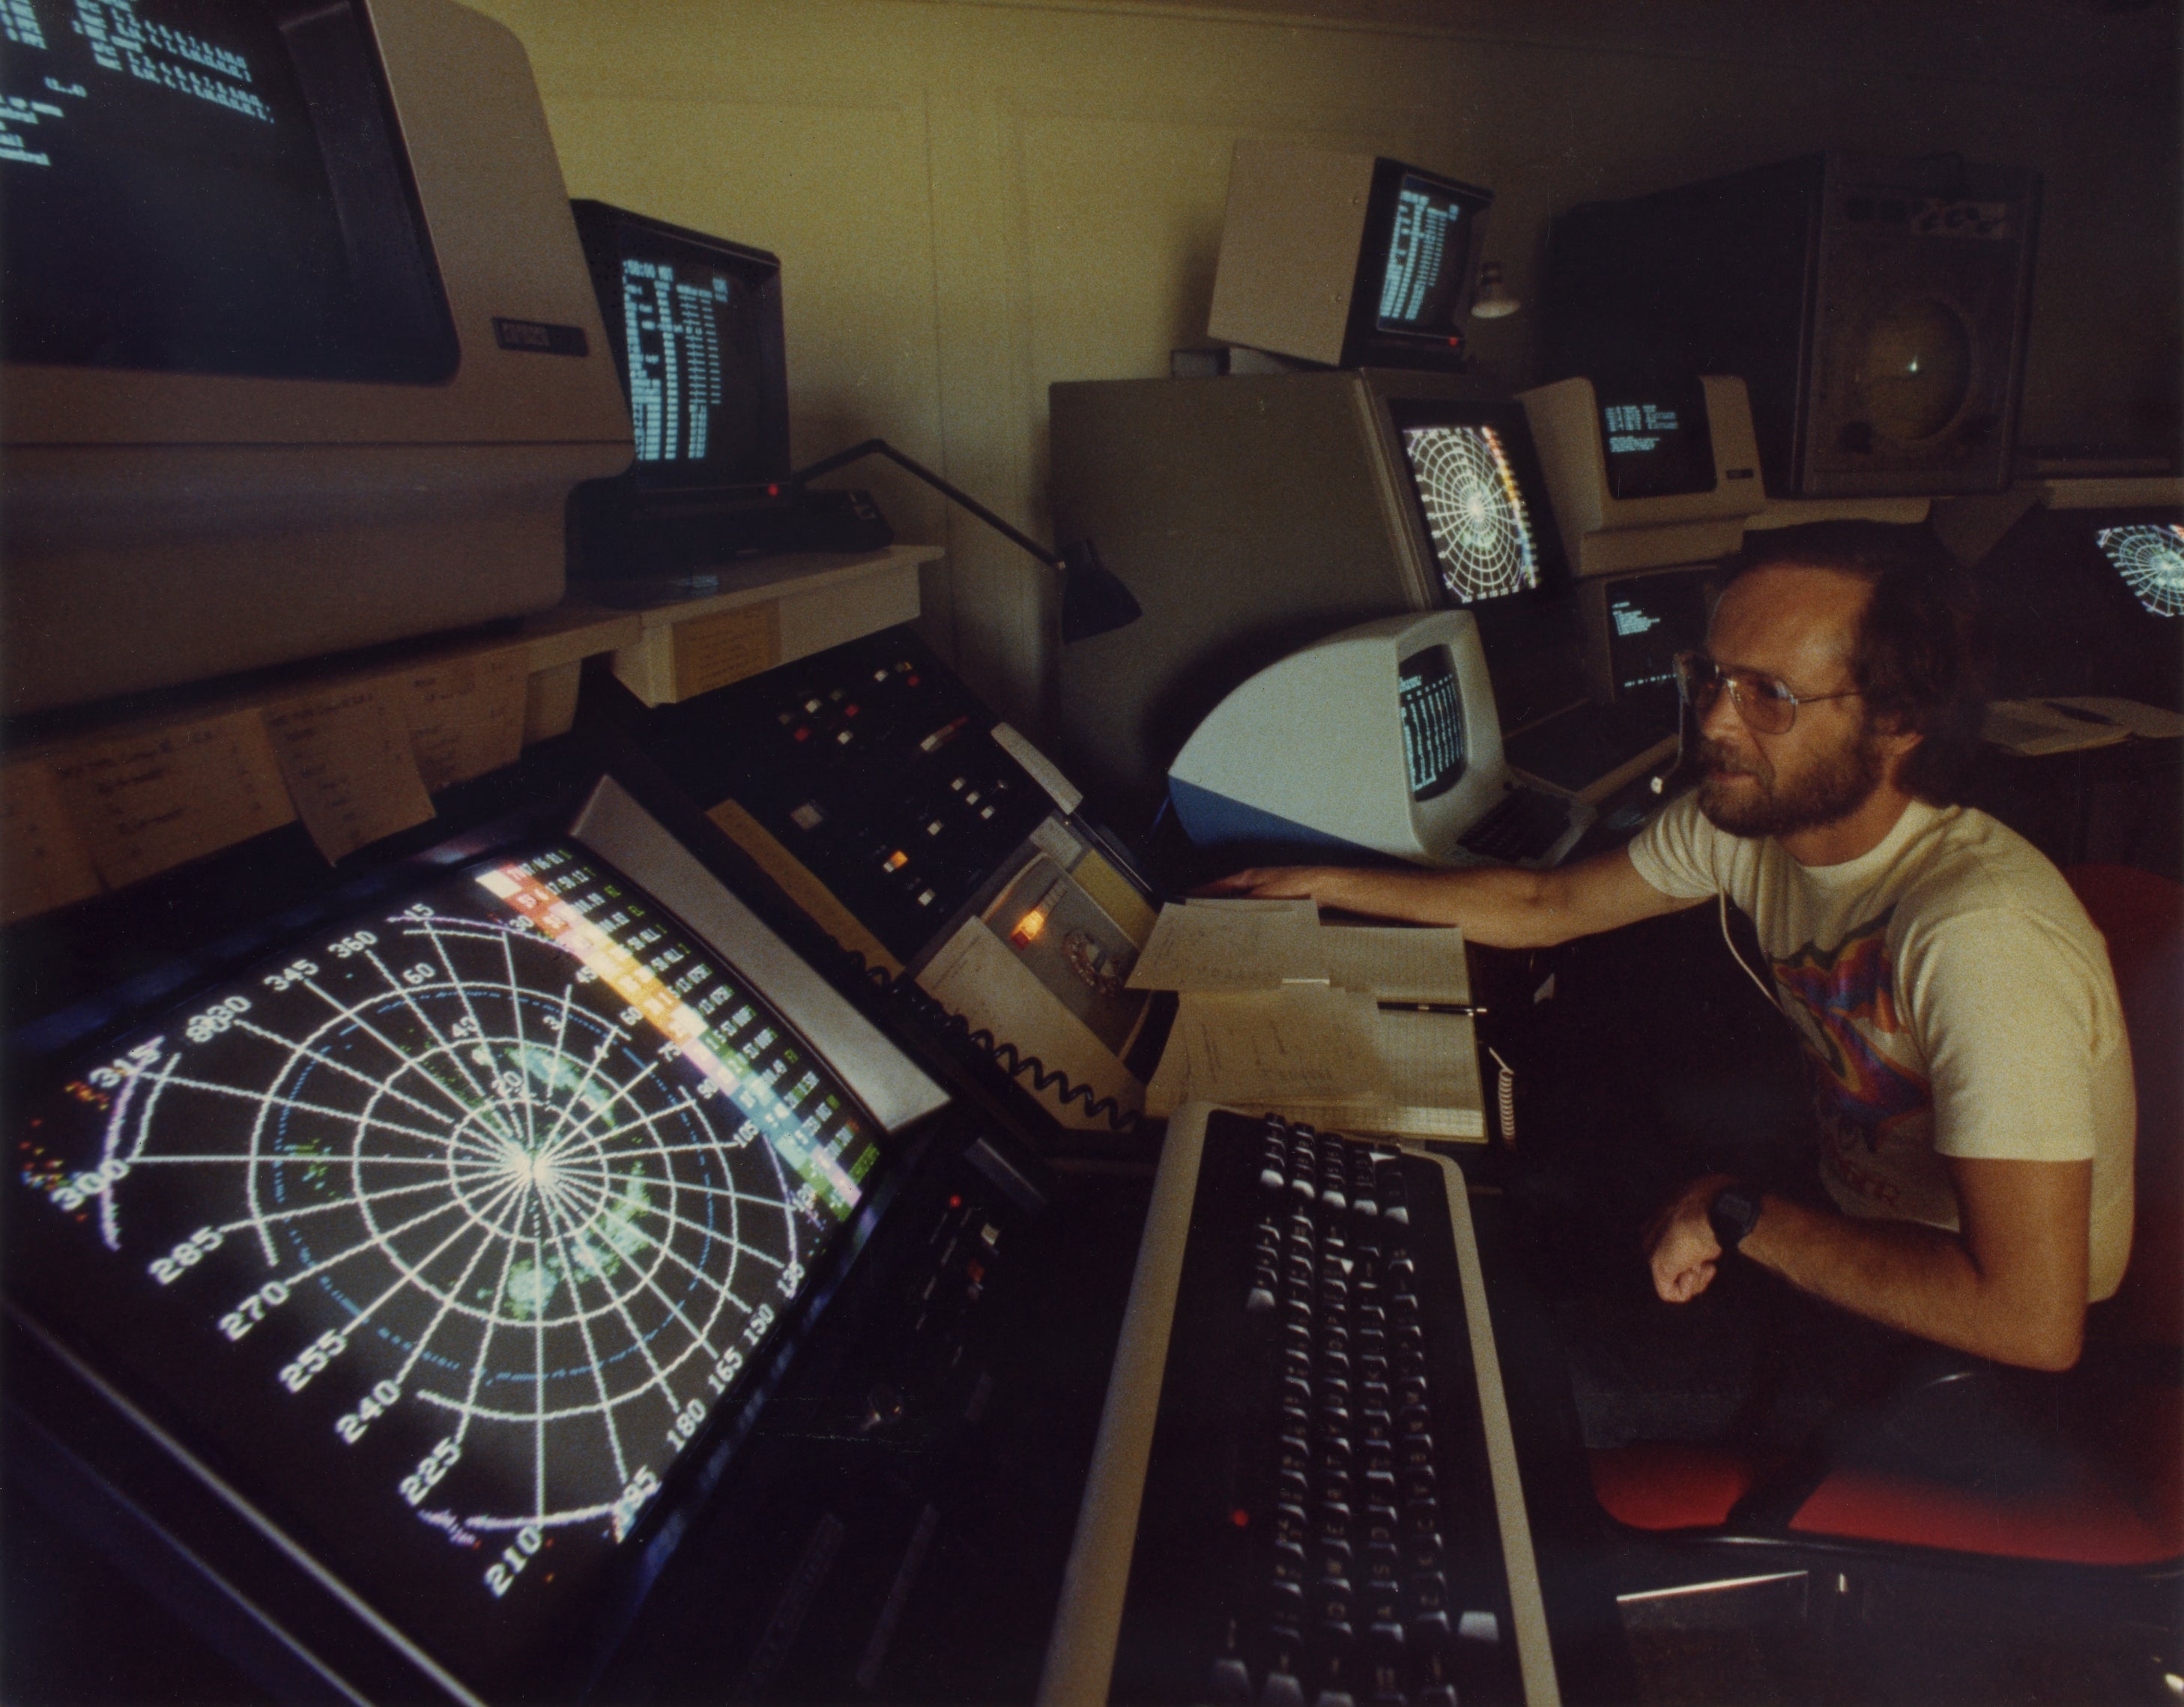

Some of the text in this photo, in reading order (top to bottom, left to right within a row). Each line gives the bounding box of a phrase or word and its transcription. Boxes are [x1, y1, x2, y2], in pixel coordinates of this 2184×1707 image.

[404, 903, 435, 921] 15
[509, 915, 535, 932] 30
[327, 930, 377, 959] 360
[264, 959, 318, 992] 345
[402, 962, 435, 985] 60
[620, 1006, 643, 1025] 60
[88, 1036, 165, 1088] 315
[49, 1156, 130, 1211] 300
[148, 1226, 225, 1286] 285
[217, 1280, 291, 1341] 270
[742, 1303, 775, 1346] 150
[278, 1329, 348, 1394] 255
[707, 1345, 744, 1395] 165
[335, 1379, 401, 1446] 240
[666, 1398, 707, 1453] 180
[399, 1436, 462, 1506] 225
[483, 1525, 542, 1598] 210
